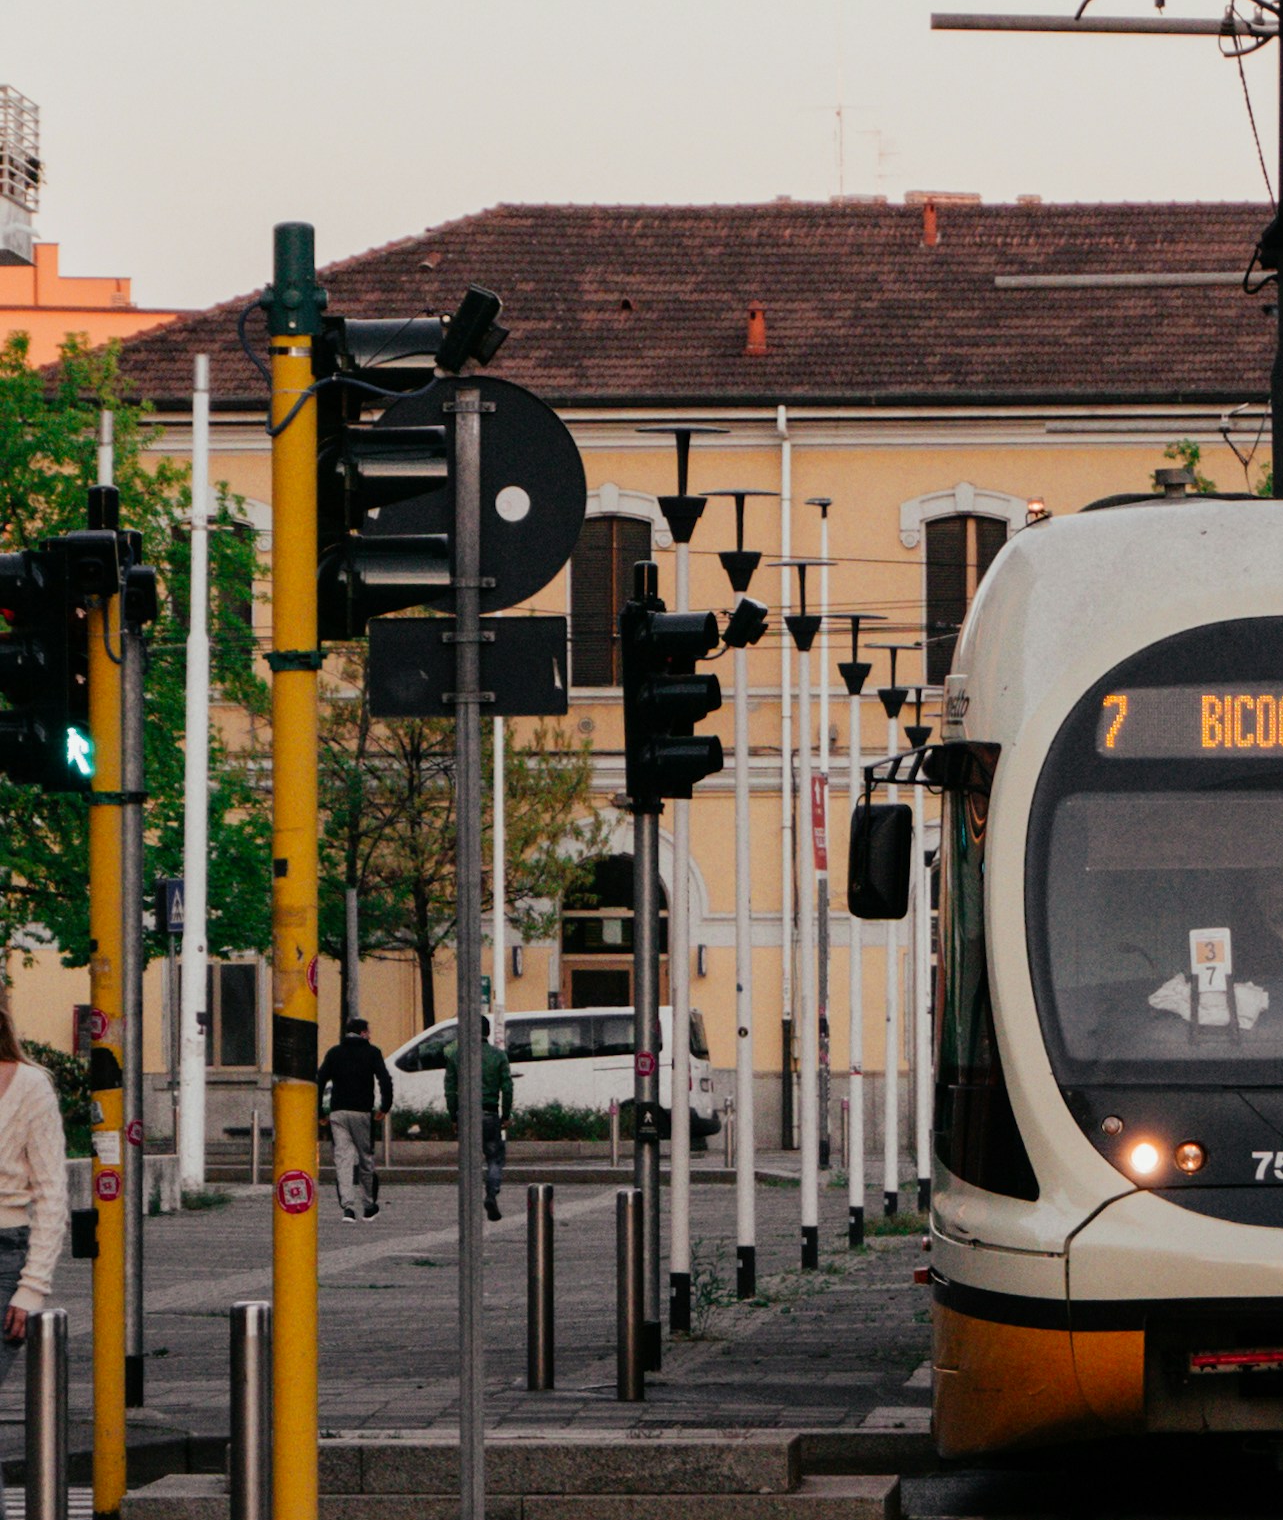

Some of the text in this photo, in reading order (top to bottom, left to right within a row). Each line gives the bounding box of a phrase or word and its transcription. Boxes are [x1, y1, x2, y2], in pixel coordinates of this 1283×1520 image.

[1103, 694, 1128, 748] 7
[1204, 941, 1217, 961] 3
[1205, 966, 1217, 986] 7
